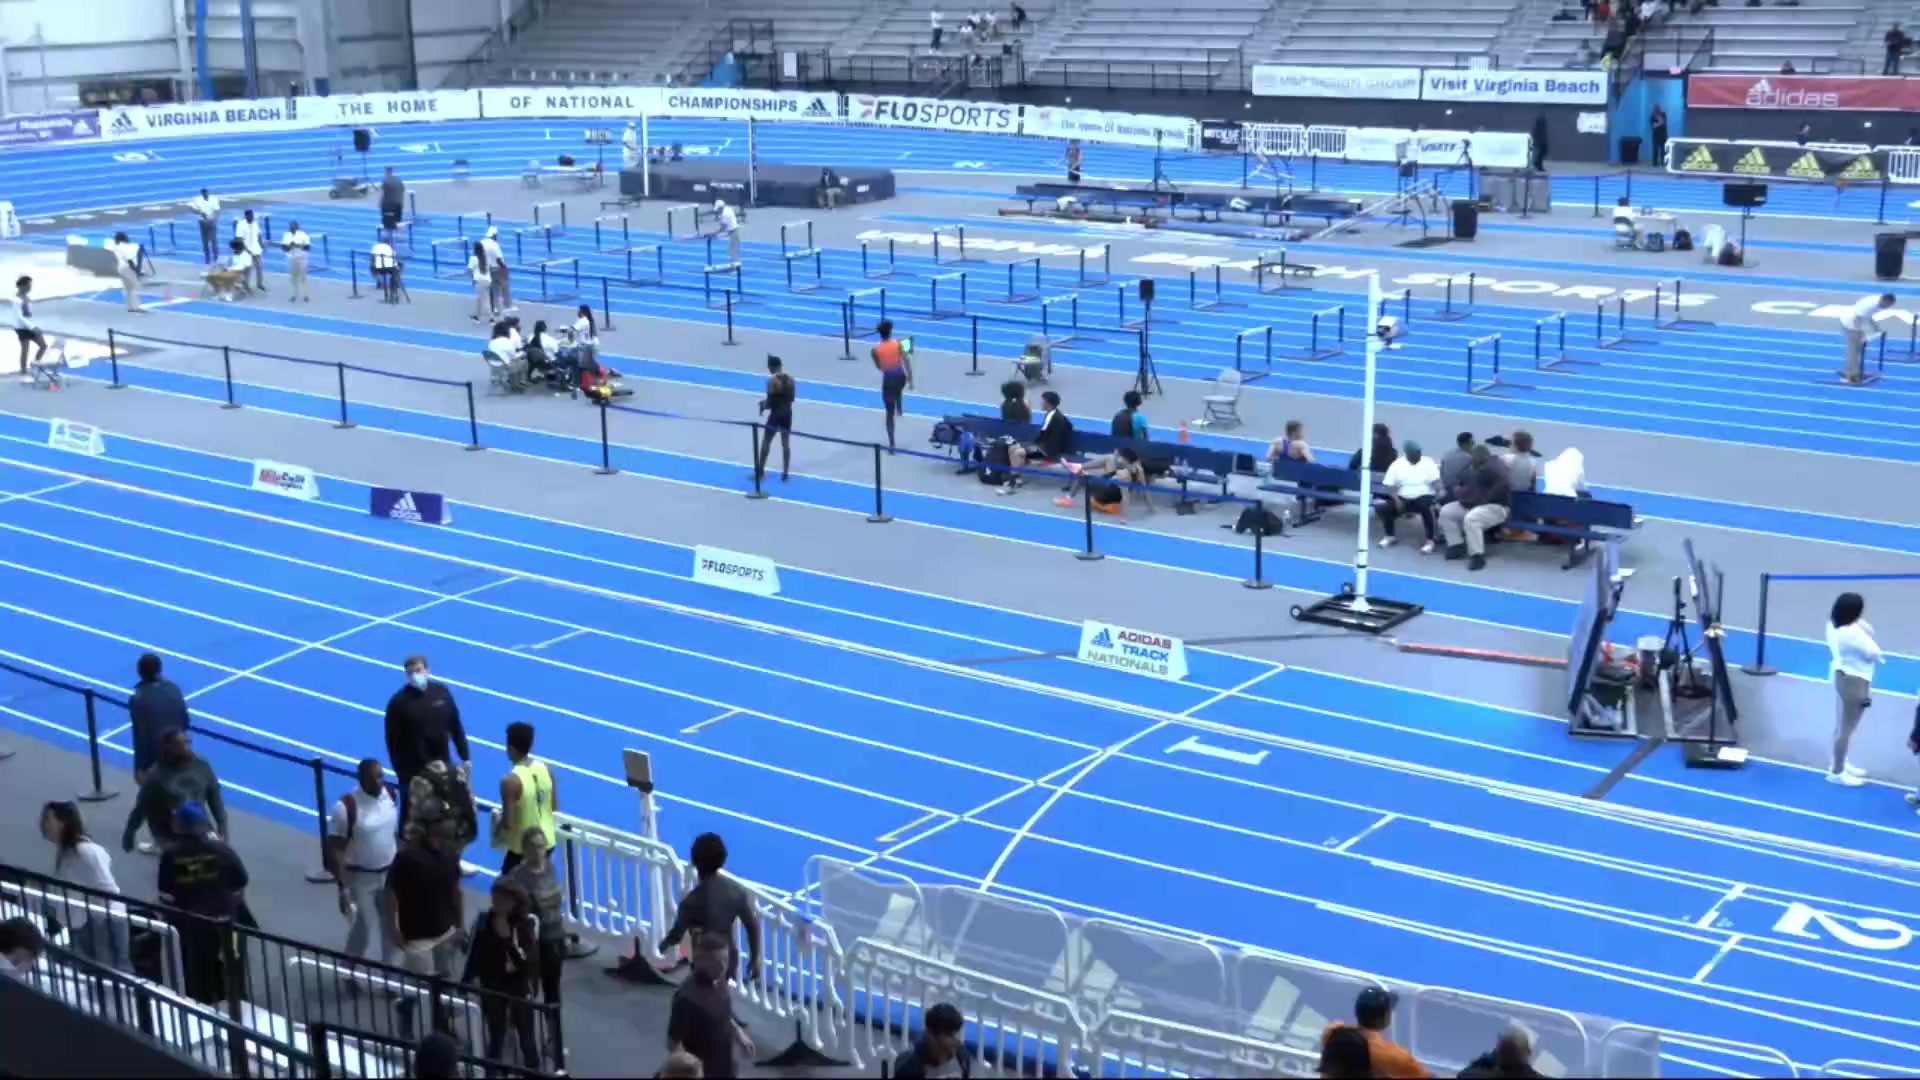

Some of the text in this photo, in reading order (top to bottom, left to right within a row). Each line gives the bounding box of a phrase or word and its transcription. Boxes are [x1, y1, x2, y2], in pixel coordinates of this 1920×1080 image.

[1430, 77, 1600, 95] Visit Virginia Beach
[510, 95, 635, 109] OF NATIONAL
[668, 95, 798, 113] CHAMPIONSHIPS
[1745, 88, 1839, 107] adidas
[338, 99, 438, 116] THE HOME
[146, 108, 281, 128] VIRGINIA BEACH
[1392, 272, 1719, 306] SPORTS
[1118, 631, 1172, 649] ADIDAS
[1122, 644, 1168, 662] TRACK
[1088, 650, 1168, 675] NATIONALS
[1772, 902, 1913, 950] 2
